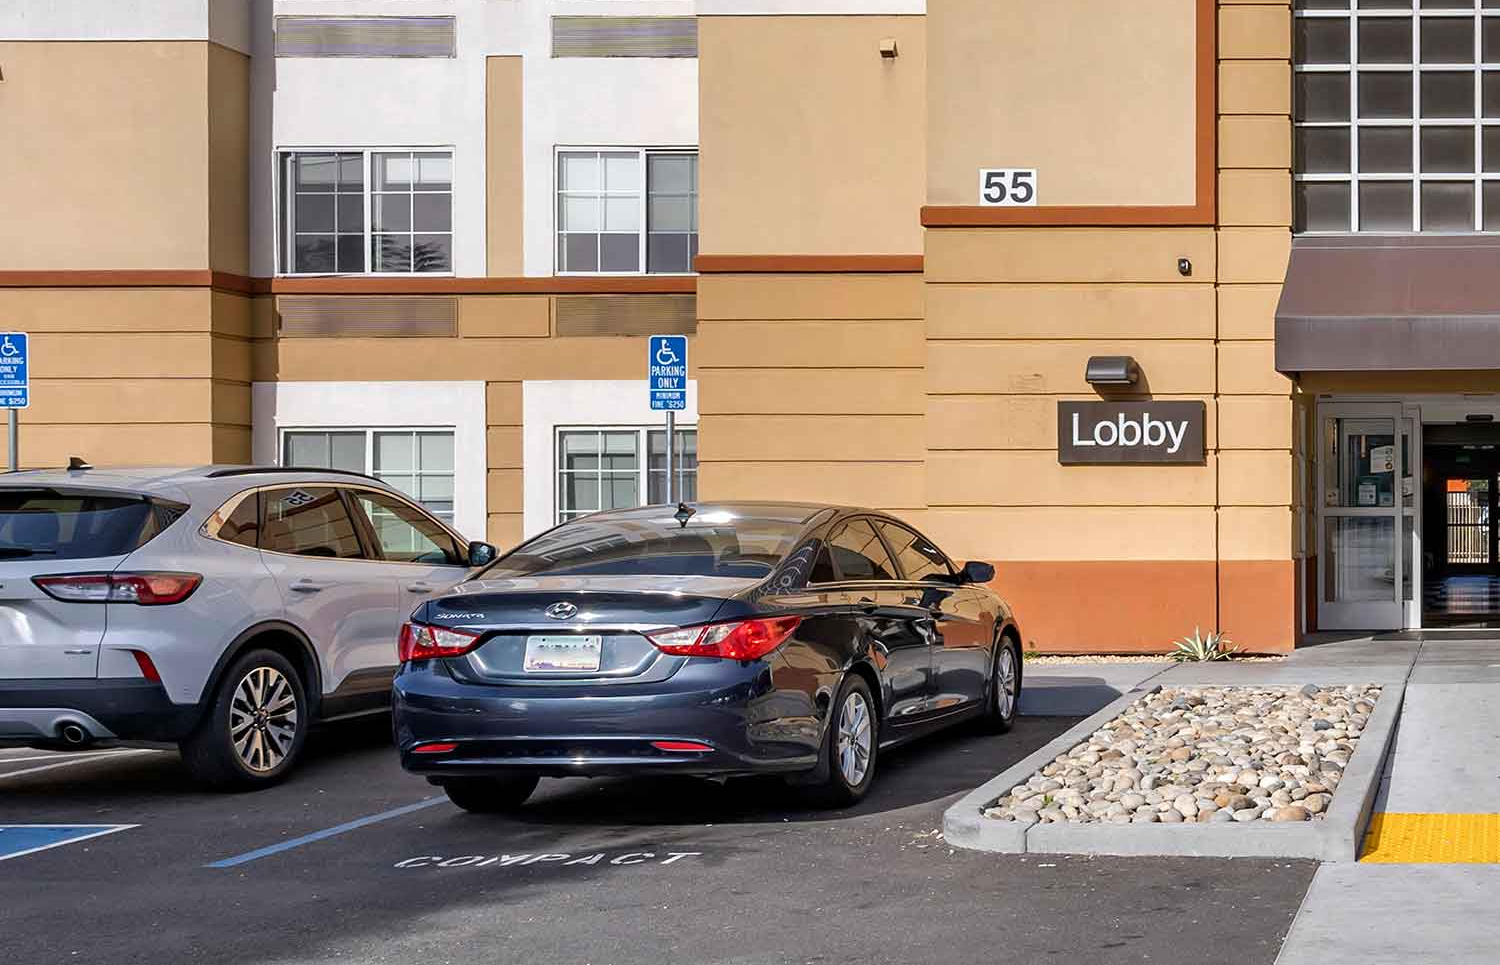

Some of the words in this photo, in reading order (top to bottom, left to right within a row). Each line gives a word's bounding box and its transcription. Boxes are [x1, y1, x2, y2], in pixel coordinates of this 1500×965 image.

[983, 171, 1034, 204] 55
[651, 365, 686, 377] PARKING
[657, 377, 679, 389] ONLY
[1071, 412, 1189, 454] Lobby
[393, 852, 703, 868] COMPACT
